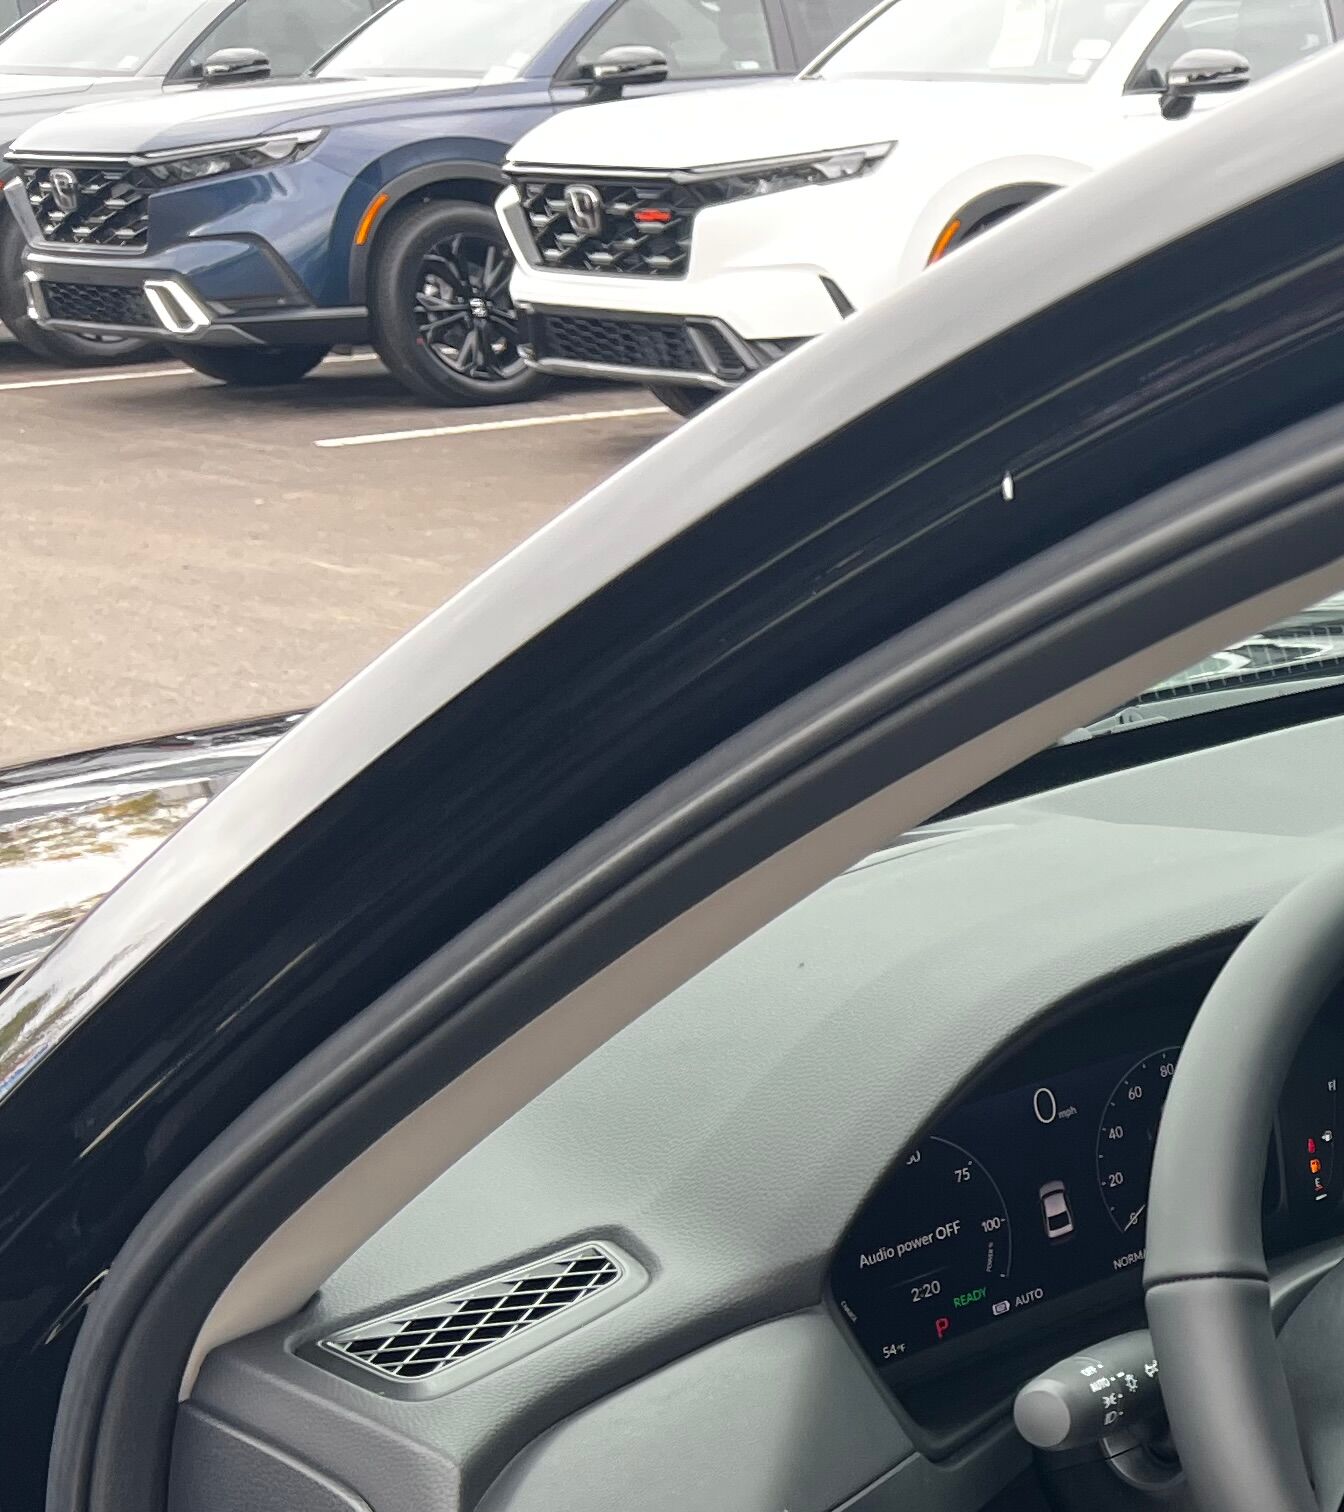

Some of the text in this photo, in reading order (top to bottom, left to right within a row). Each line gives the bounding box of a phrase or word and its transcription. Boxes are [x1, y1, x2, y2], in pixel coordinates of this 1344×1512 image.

[1159, 1063, 1175, 1078] 80
[1128, 1086, 1142, 1100] 60
[1033, 1088, 1077, 1124] 0 mph
[1108, 1126, 1124, 1140] 40
[954, 1167, 971, 1183] 75
[1108, 1172, 1124, 1187] 20
[981, 1217, 1001, 1233] 100
[859, 1220, 961, 1269] Audio power OFF
[1113, 1249, 1145, 1269] NORM
[911, 1280, 941, 1302] 2:20
[953, 1287, 988, 1308] READY
[1014, 1288, 1044, 1307] AUTO
[935, 1317, 949, 1339] P
